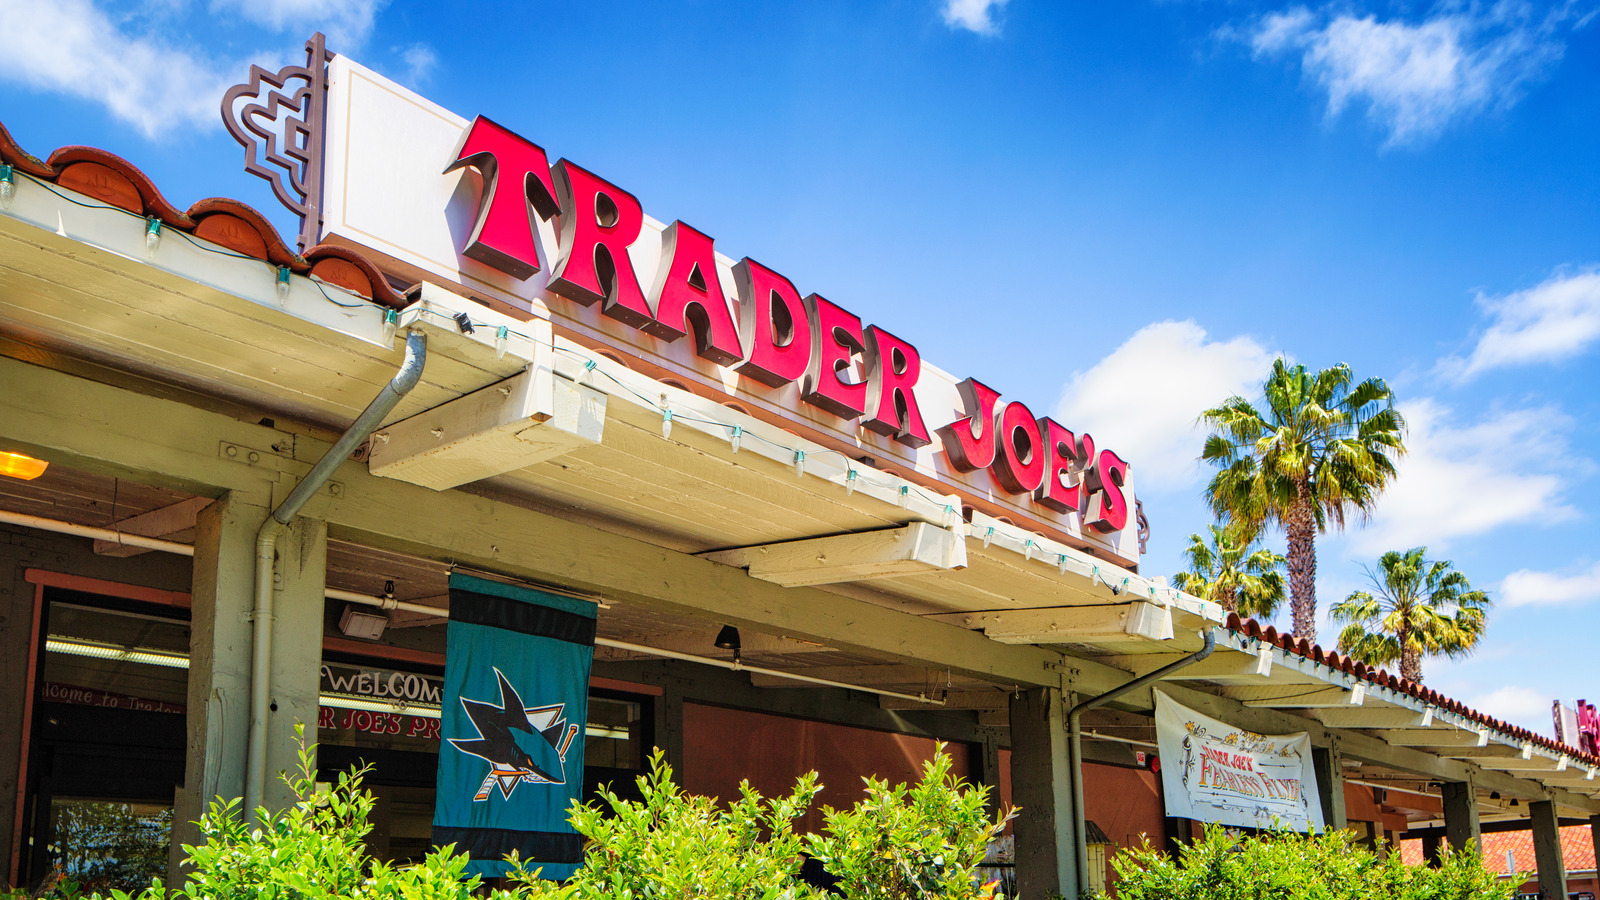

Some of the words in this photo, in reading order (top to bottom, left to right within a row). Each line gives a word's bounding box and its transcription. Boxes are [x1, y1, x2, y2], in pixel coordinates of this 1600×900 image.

[443, 114, 932, 449] TRADER
[934, 377, 1128, 534] JOE'S
[42, 682, 93, 702] lcome
[103, 692, 118, 708] to
[320, 664, 444, 703] WELCOM
[387, 697, 407, 711] TO
[340, 709, 402, 735] JOE'S
[1231, 754, 1253, 771] JOE'S
[1198, 753, 1265, 799] FEARLESS
[1256, 772, 1300, 802] FLYER
